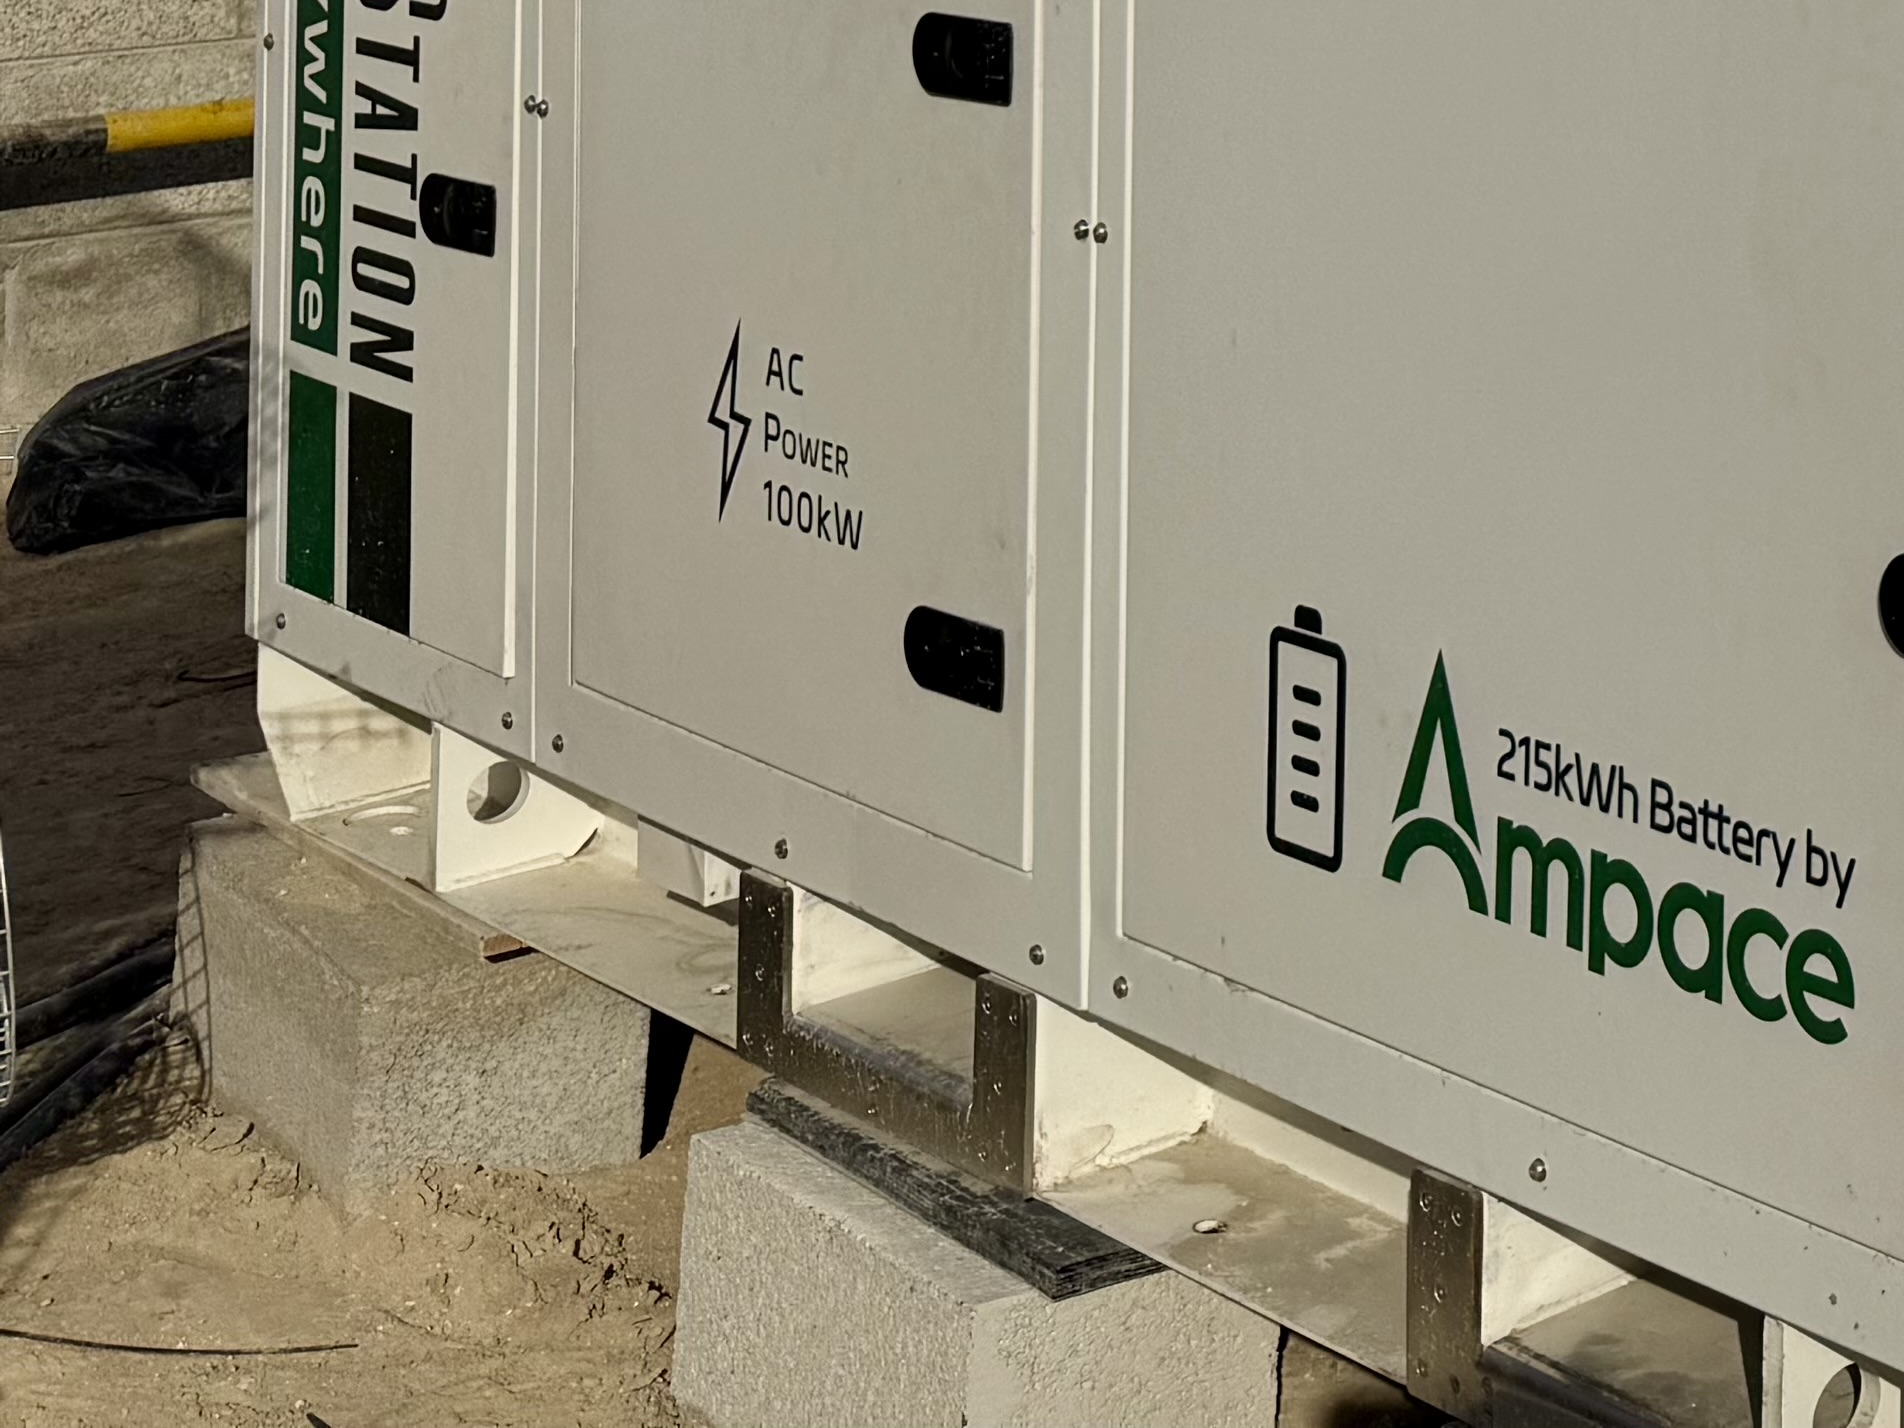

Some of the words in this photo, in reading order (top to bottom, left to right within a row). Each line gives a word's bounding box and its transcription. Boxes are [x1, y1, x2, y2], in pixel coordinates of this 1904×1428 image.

[766, 347, 804, 396] AC
[764, 412, 848, 478] POWER
[763, 480, 863, 550] 100kW
[1382, 648, 1855, 1044] Ampace
[1497, 728, 1639, 825] 215kWh
[1650, 777, 1796, 887] Battery
[1806, 829, 1856, 908] by
